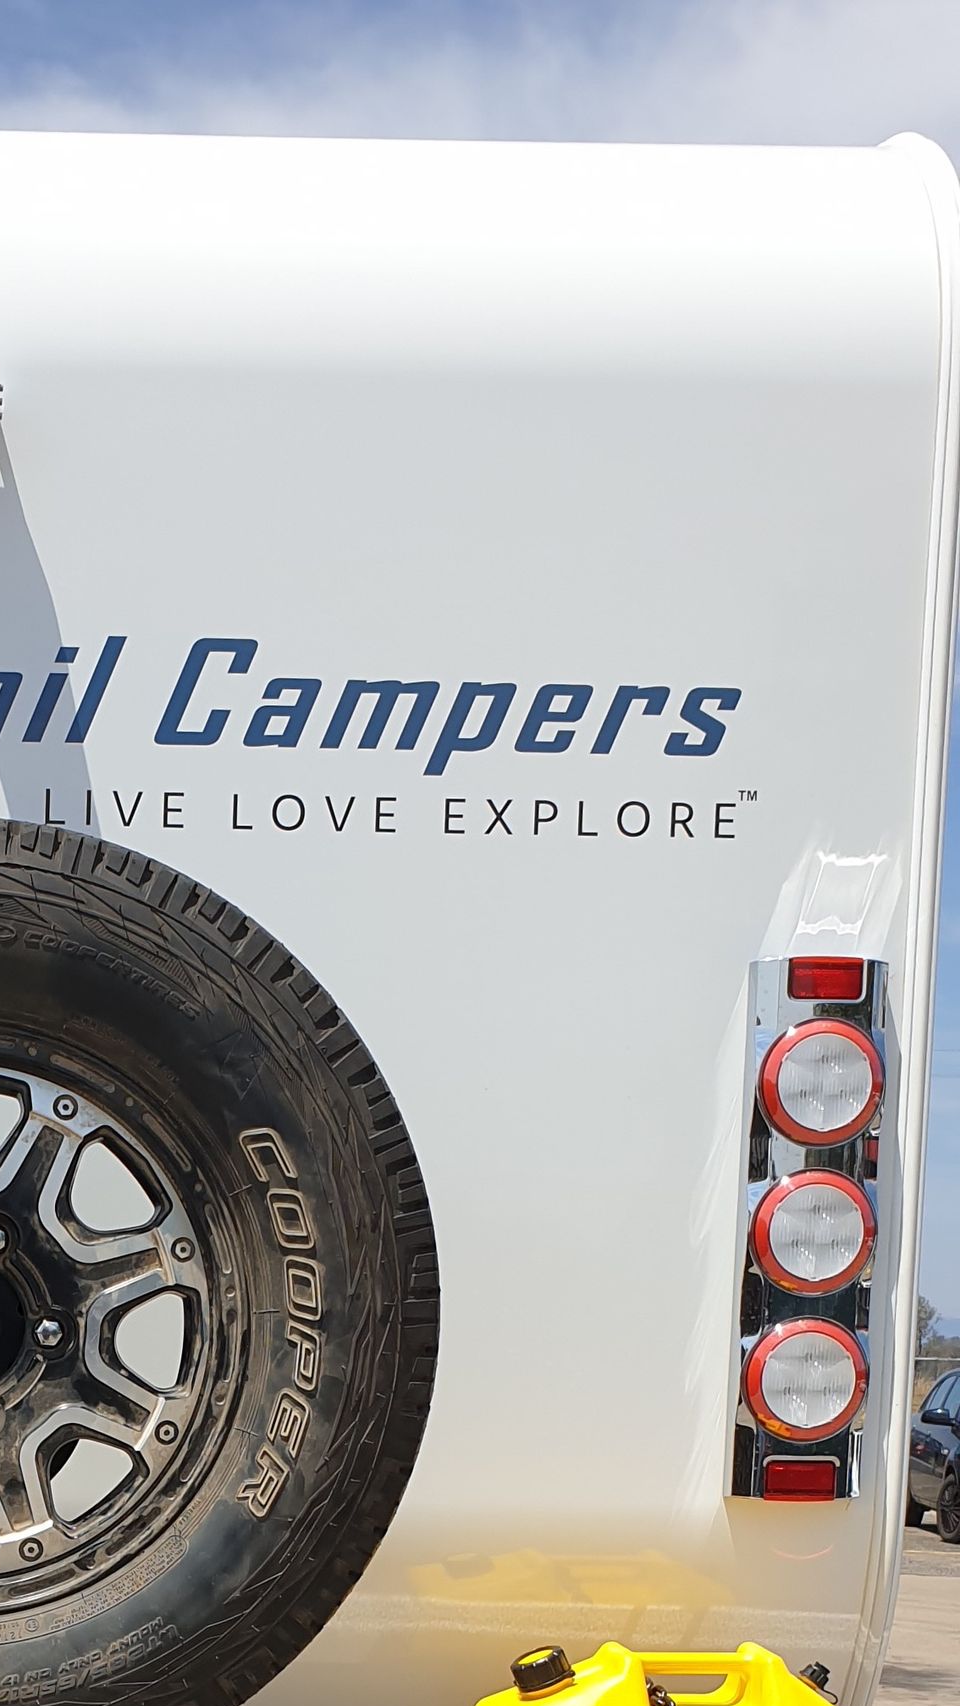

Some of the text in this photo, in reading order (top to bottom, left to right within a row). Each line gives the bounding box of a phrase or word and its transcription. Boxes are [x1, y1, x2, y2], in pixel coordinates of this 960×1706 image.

[153, 637, 742, 776] Campers
[44, 788, 185, 828] LIVE
[232, 794, 397, 833] LOVE
[444, 798, 737, 839] EXPLORE
[237, 1127, 324, 1521] COOPER
